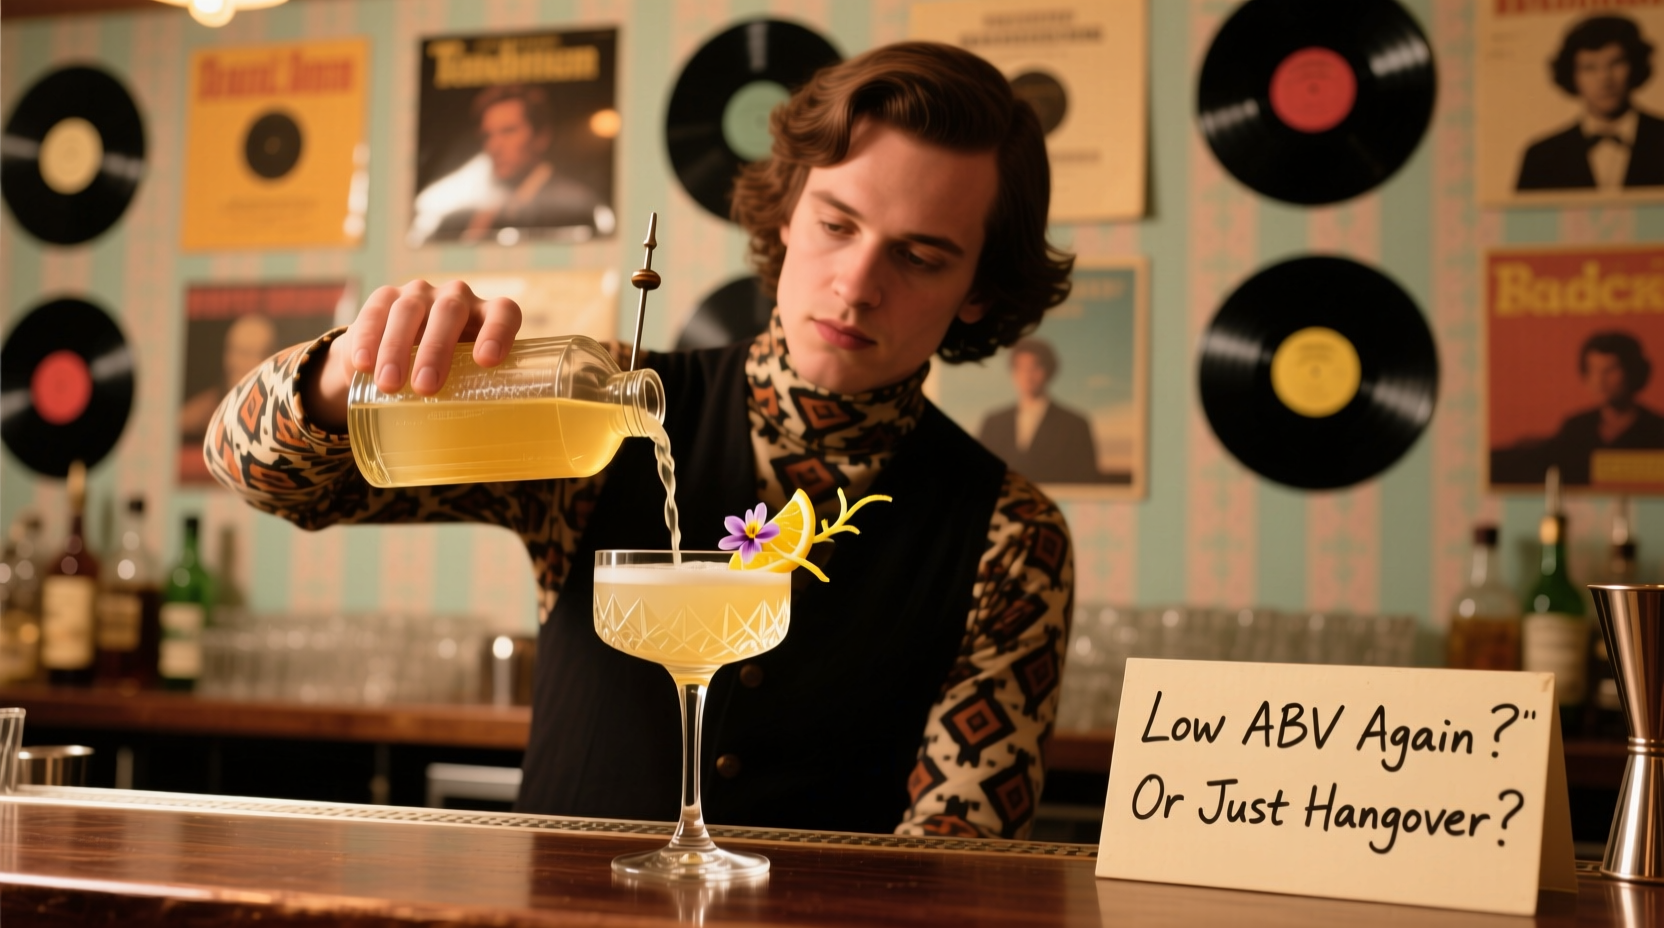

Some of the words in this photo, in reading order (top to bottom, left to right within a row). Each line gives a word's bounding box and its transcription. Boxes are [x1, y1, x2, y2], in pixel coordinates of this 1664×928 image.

[1141, 690, 1226, 744] Low
[1241, 700, 1346, 750] ABV
[1131, 773, 1185, 820] Or
[1198, 778, 1290, 825] Just
[1304, 782, 1525, 855] Hangover?
